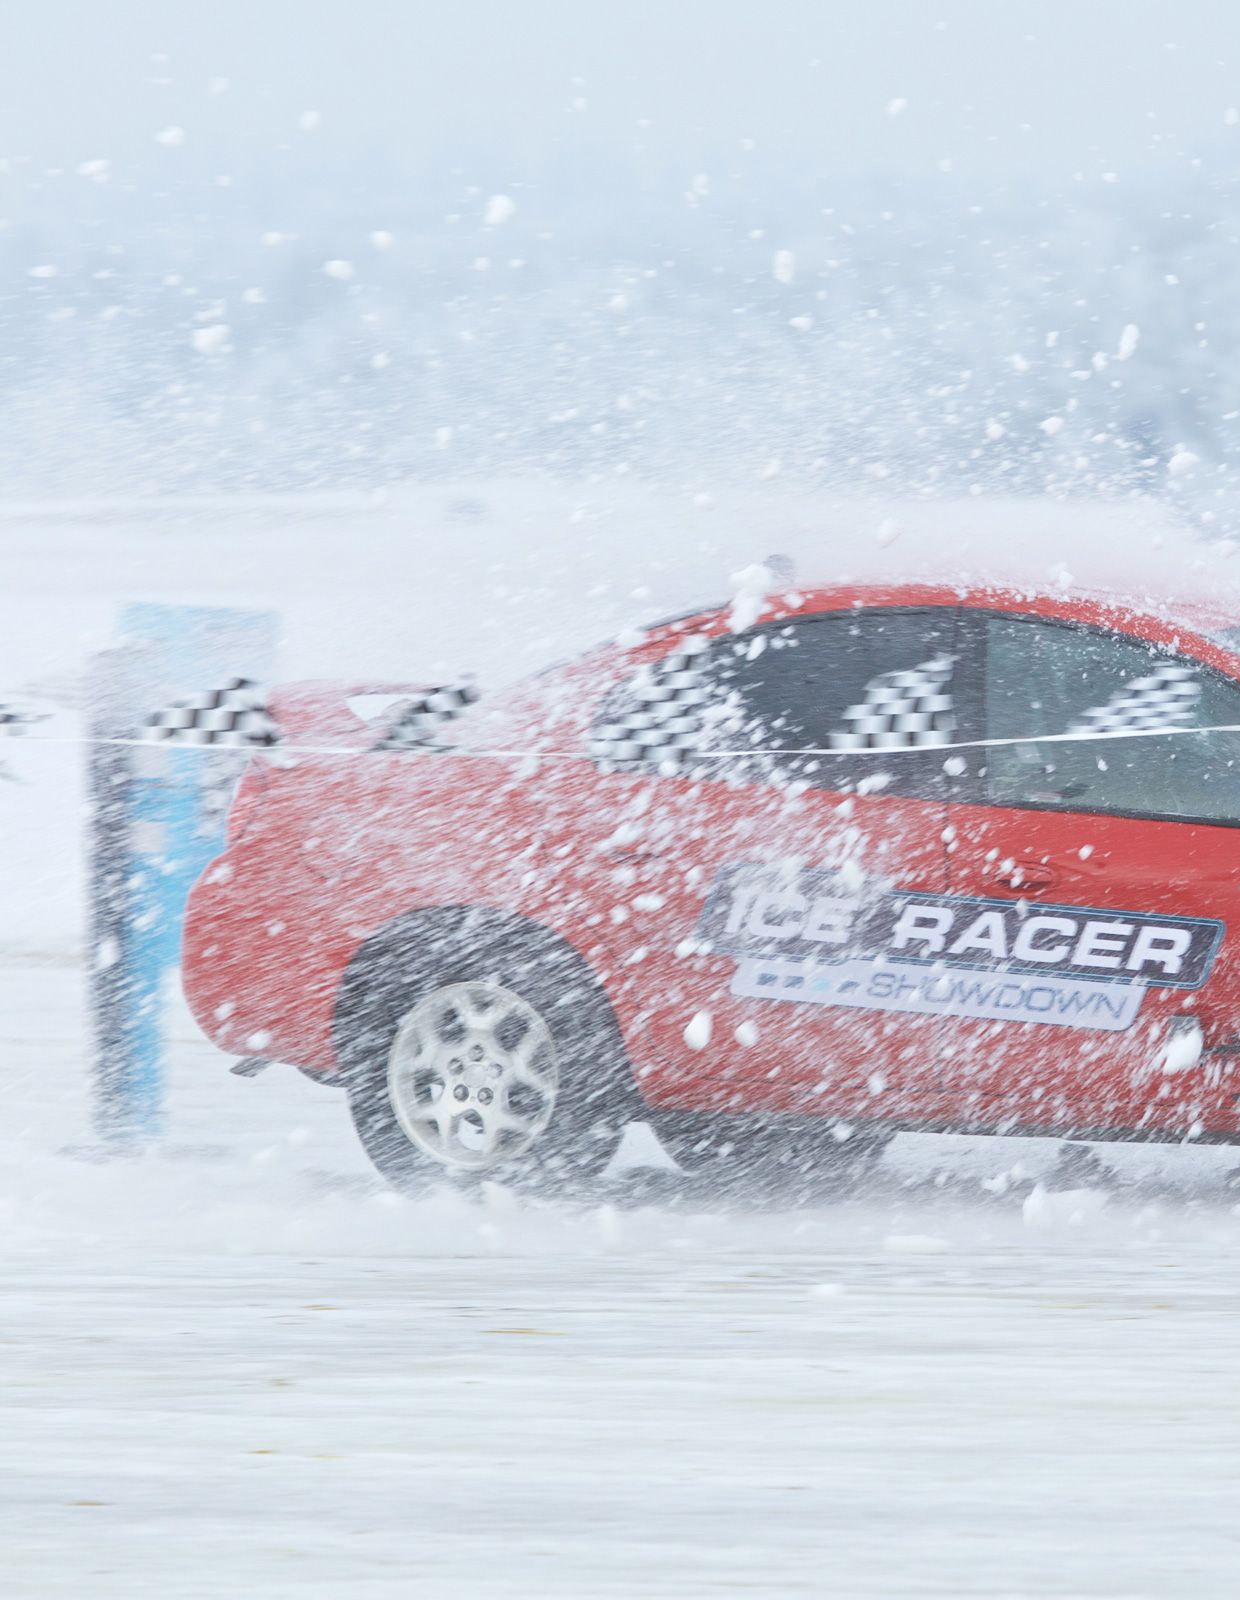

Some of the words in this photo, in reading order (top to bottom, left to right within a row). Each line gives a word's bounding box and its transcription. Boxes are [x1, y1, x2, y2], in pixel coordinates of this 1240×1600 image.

[724, 892, 860, 944] ICE
[891, 905, 1191, 975] RACER
[867, 971, 1128, 1020] SHOWDOWN
